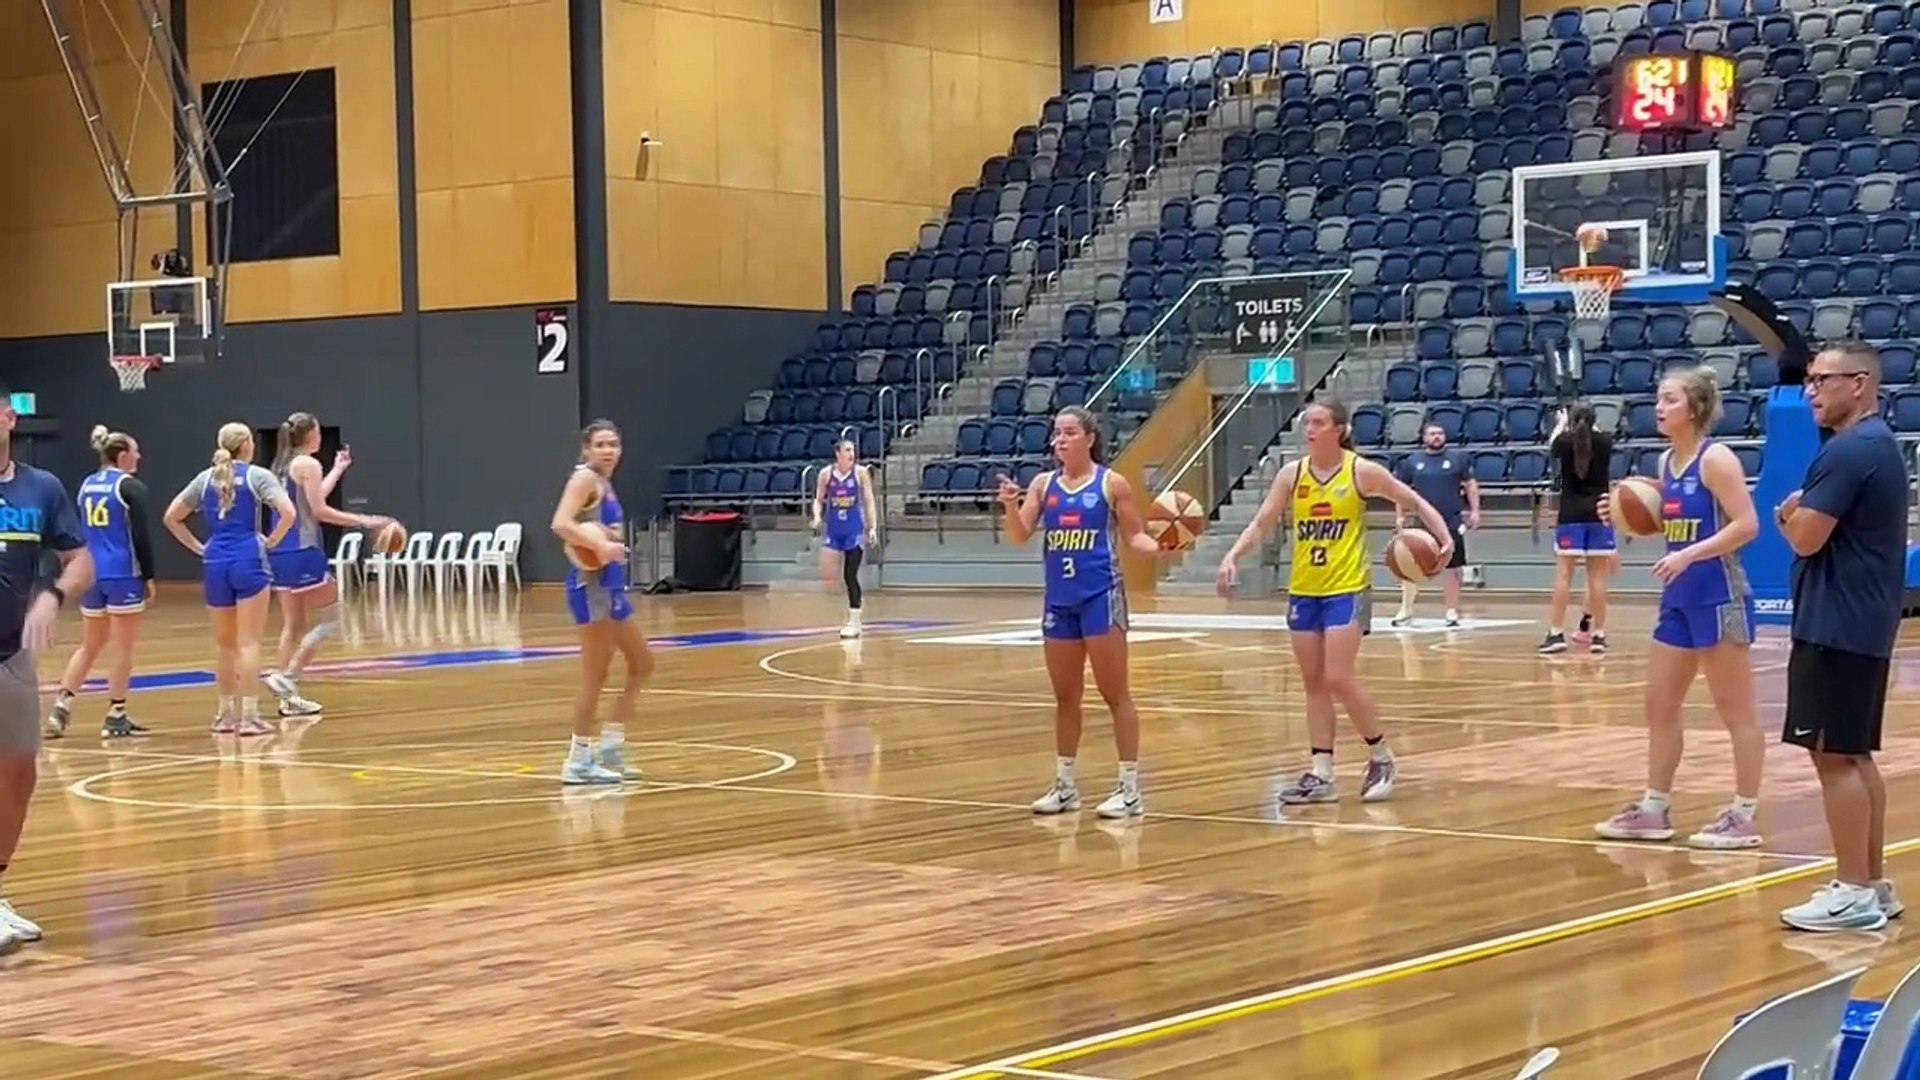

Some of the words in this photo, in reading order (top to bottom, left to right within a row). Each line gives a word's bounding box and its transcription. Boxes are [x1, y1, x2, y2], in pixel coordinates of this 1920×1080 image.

[1235, 297, 1303, 316] TOILETS
[538, 322, 567, 373] 2
[85, 496, 109, 527] 16
[1047, 529, 1099, 551] SPIRIT
[1298, 518, 1349, 542] SPIRIT
[1062, 557, 1076, 578] 3
